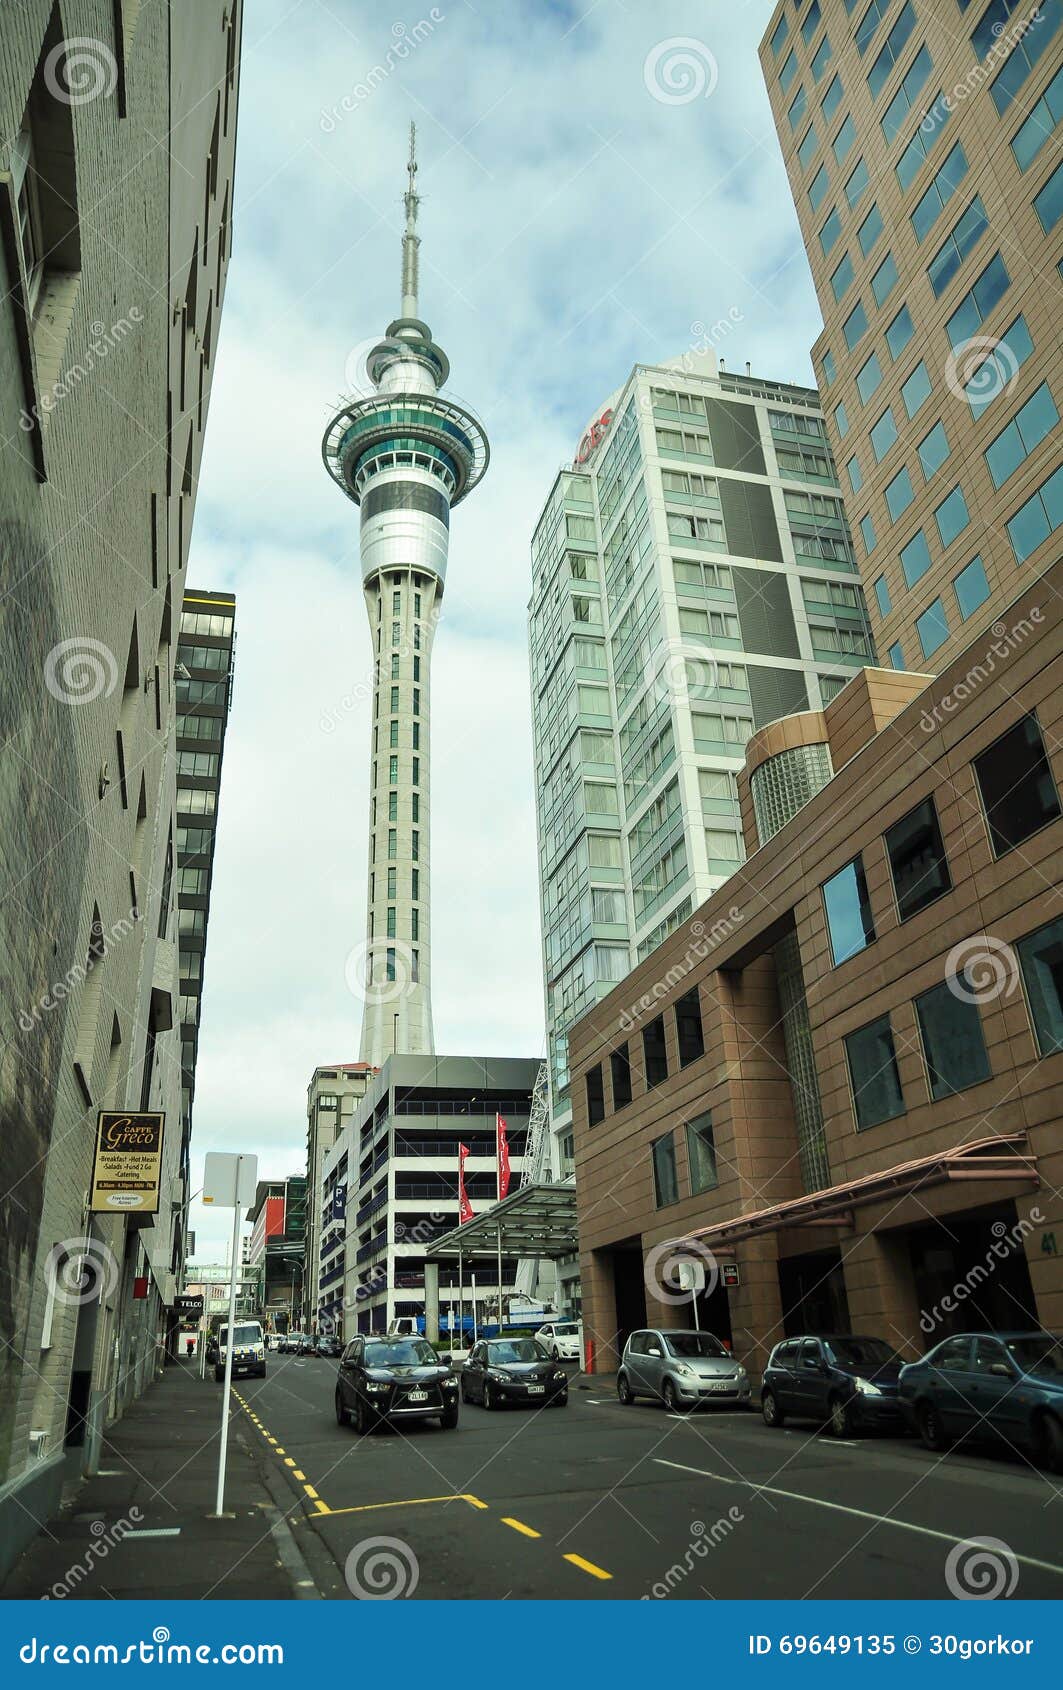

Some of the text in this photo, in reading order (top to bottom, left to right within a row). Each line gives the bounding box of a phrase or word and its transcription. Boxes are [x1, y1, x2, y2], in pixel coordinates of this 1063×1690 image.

[107, 1118, 154, 1150] Greco
[335, 1188, 343, 1198] P
[180, 1300, 202, 1308] TELCO
